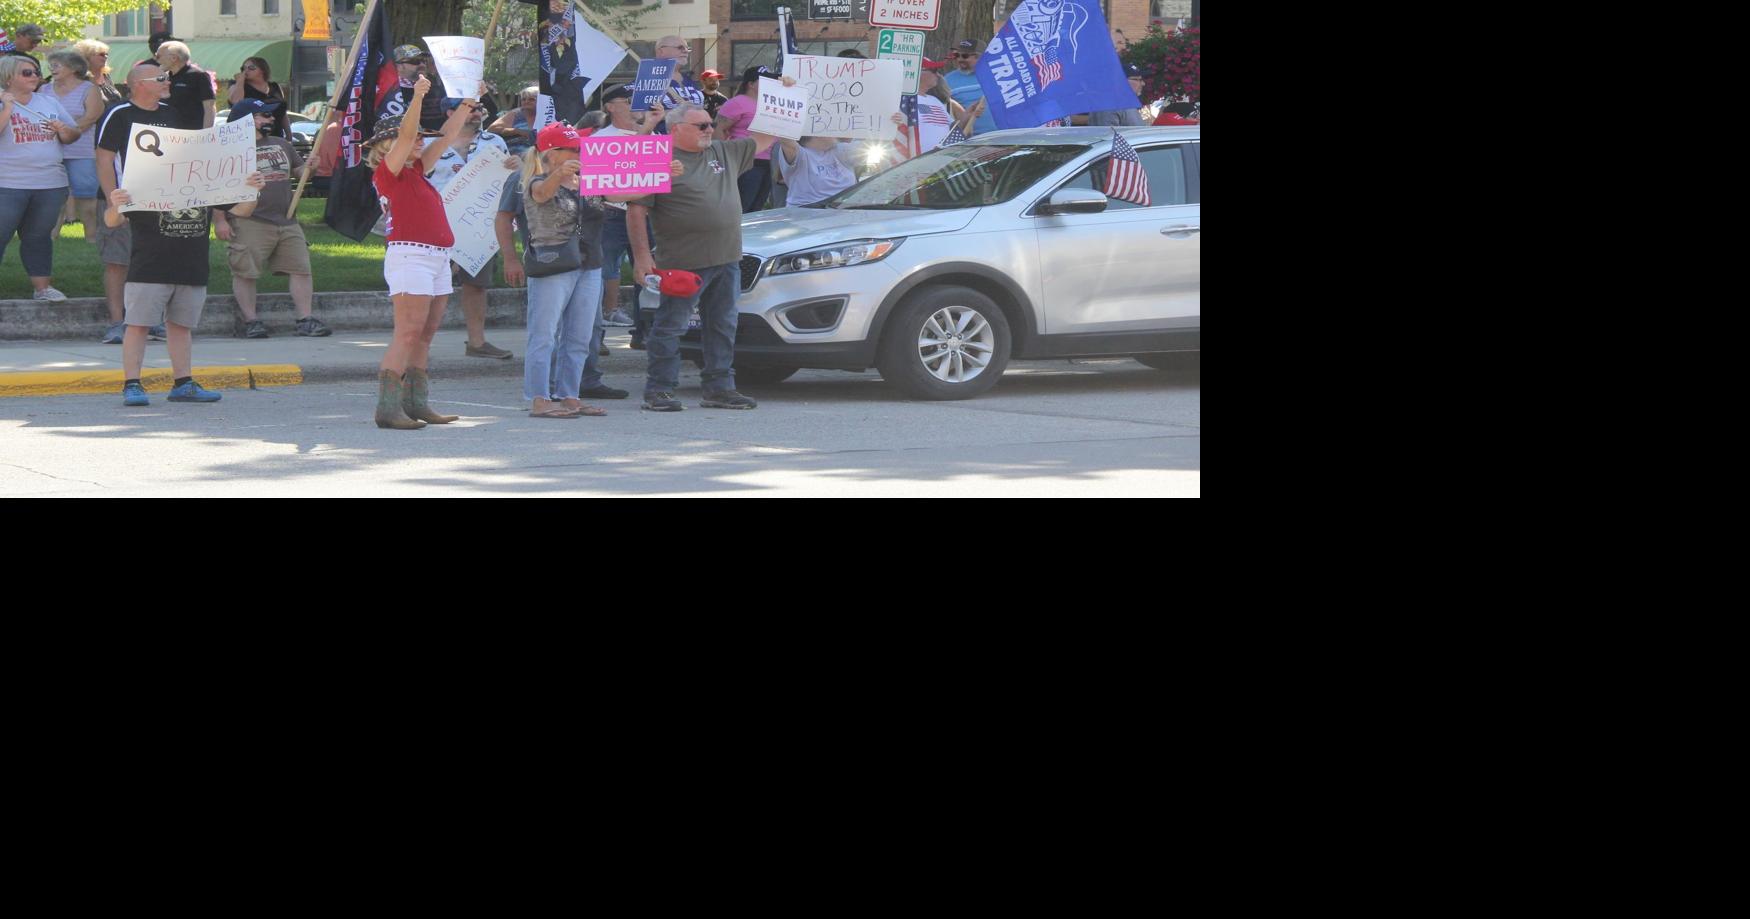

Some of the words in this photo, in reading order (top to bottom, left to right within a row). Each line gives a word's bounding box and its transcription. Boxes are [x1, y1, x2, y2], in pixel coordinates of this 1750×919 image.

[880, 9, 887, 17] 2
[893, 9, 929, 20] INCHES
[880, 34, 892, 50] 2
[903, 35, 914, 43] HR
[893, 44, 920, 53] PARKING
[1005, 36, 1016, 50] ALL
[651, 65, 667, 75] KEEP
[792, 57, 876, 80] TRUMP
[1010, 50, 1033, 83] ABOARD
[804, 81, 864, 101] 2020
[1024, 82, 1037, 98] THE
[763, 94, 804, 110] TRUMP
[765, 106, 799, 119] PENCE
[135, 129, 164, 157] Q
[584, 140, 670, 156] WOMEN
[161, 146, 256, 185] TRUMP
[614, 161, 637, 170] FOR
[155, 178, 242, 197] 2020
[581, 172, 670, 190] TRUMP
[458, 179, 503, 226] TRUMP
